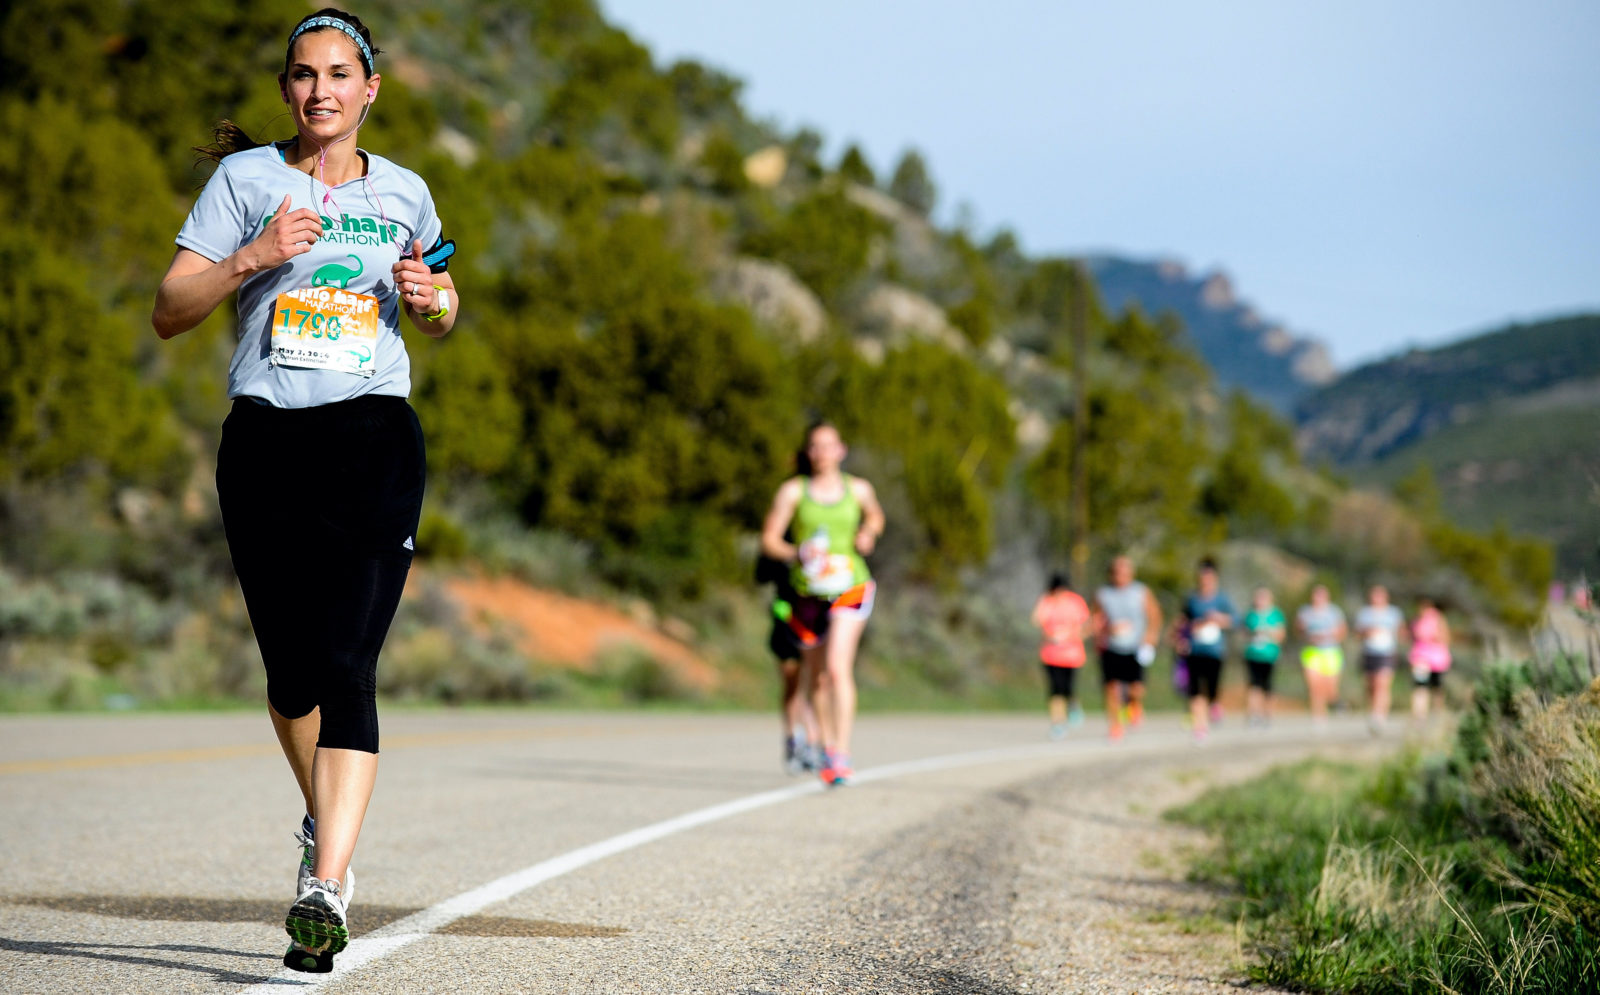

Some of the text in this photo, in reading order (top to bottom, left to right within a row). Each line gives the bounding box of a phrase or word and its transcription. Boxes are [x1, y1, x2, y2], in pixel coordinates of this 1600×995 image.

[340, 213, 398, 244] half
[316, 232, 380, 247] RATHON
[305, 299, 357, 316] MARATHON
[333, 290, 373, 314] half
[278, 347, 294, 355] May
